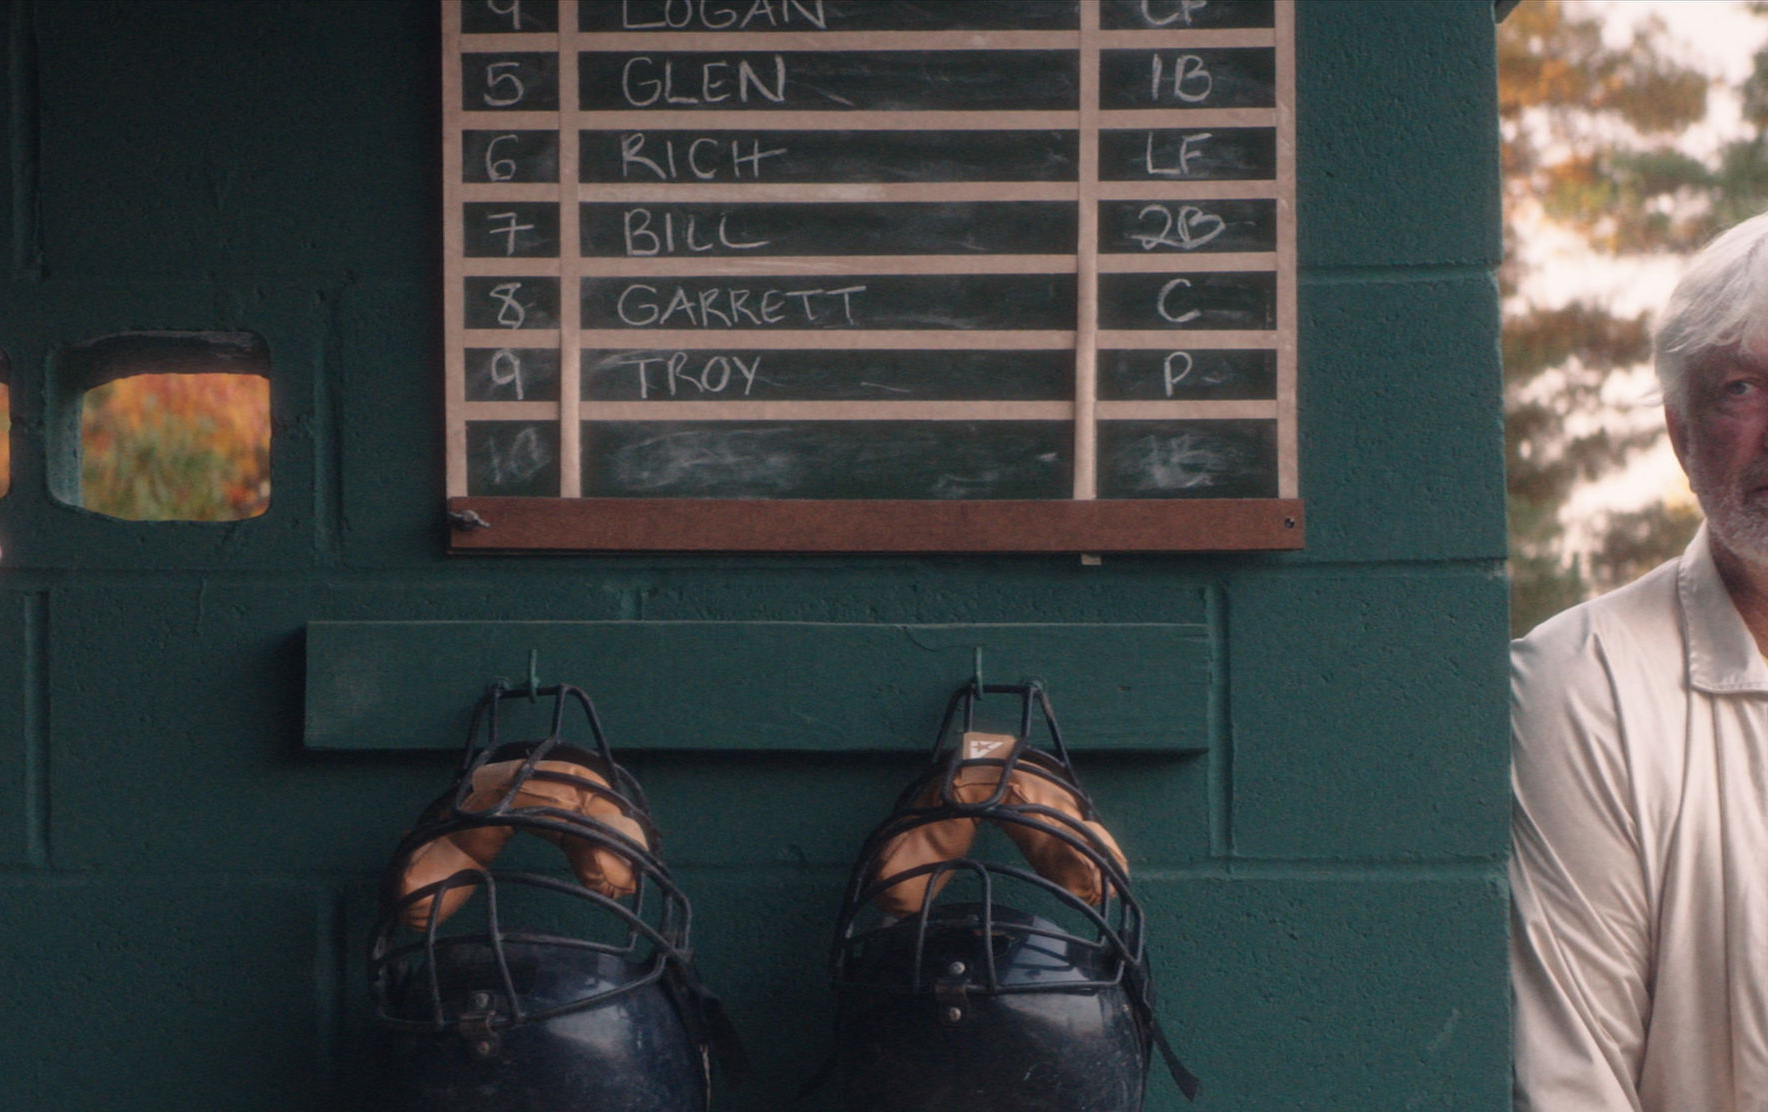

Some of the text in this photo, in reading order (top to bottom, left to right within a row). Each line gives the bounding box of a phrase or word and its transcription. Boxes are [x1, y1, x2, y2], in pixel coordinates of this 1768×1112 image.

[622, 0, 827, 29] LOGAN
[482, 53, 1213, 107] 5 GLEN 1B
[484, 130, 1214, 182] 6 RICH LF
[487, 203, 1227, 257] 7 BILL 2B
[488, 277, 1202, 330] 8 GARRETT C
[490, 348, 1193, 401] 9 TROY P
